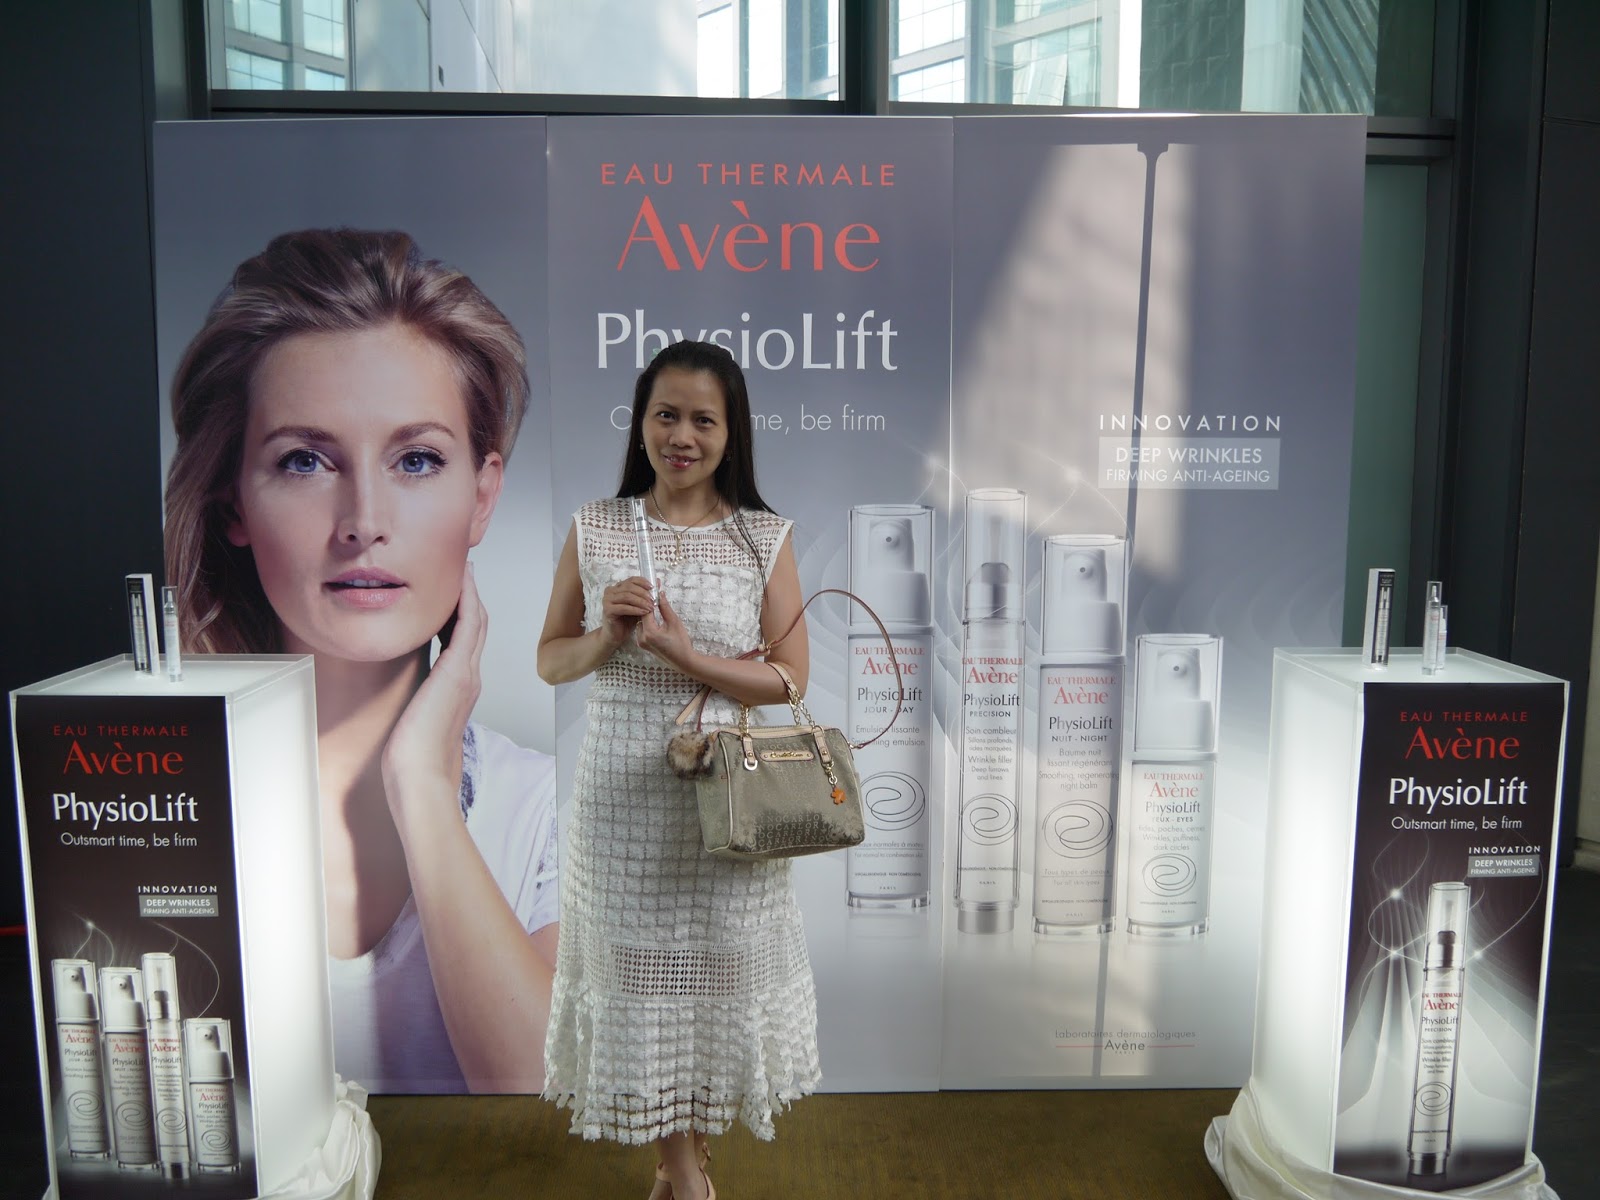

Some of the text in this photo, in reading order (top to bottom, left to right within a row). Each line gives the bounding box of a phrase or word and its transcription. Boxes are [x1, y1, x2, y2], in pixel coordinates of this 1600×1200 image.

[601, 163, 895, 186] EAU THERMALE
[617, 195, 880, 272] Avène
[801, 404, 832, 431] be
[842, 404, 885, 431] firm
[1100, 414, 1281, 432] INNOVATION
[1116, 447, 1262, 464] DEEP WRINKLES
[1106, 469, 1270, 483] FIRMING ANTI-AGEING
[855, 647, 872, 655] EAU
[978, 657, 1023, 666] THERMALE
[966, 666, 1018, 684] Avène
[1047, 676, 1117, 685] EAU THERMALE
[963, 693, 1020, 710] PhysioLift
[1053, 686, 1109, 704] Avène
[1400, 711, 1528, 722] EAU THERMALE
[53, 725, 188, 736] EAU THERMALE
[891, 725, 920, 733] lissante
[965, 726, 980, 735] Soin
[1049, 716, 1113, 734] PhysioLift
[1405, 726, 1520, 760] Avène
[63, 739, 184, 775] Avène
[1059, 748, 1086, 757] Baume
[1149, 782, 1199, 798] Avène
[1389, 776, 1528, 815] PhysioLift
[53, 792, 199, 831] PhysioLift
[1145, 801, 1201, 817] PhysioLift
[1391, 815, 1522, 831] Outsmart time, be firm
[61, 832, 197, 848] Outsmart time, be firm
[1468, 845, 1541, 854] INNOVATION
[1495, 859, 1533, 867] WRINKLES
[138, 885, 217, 893] INNOVATION
[146, 899, 210, 907] DEEP WRINKLES
[1055, 1030, 1113, 1039] Laboratoires
[1104, 1039, 1146, 1051] Avène
